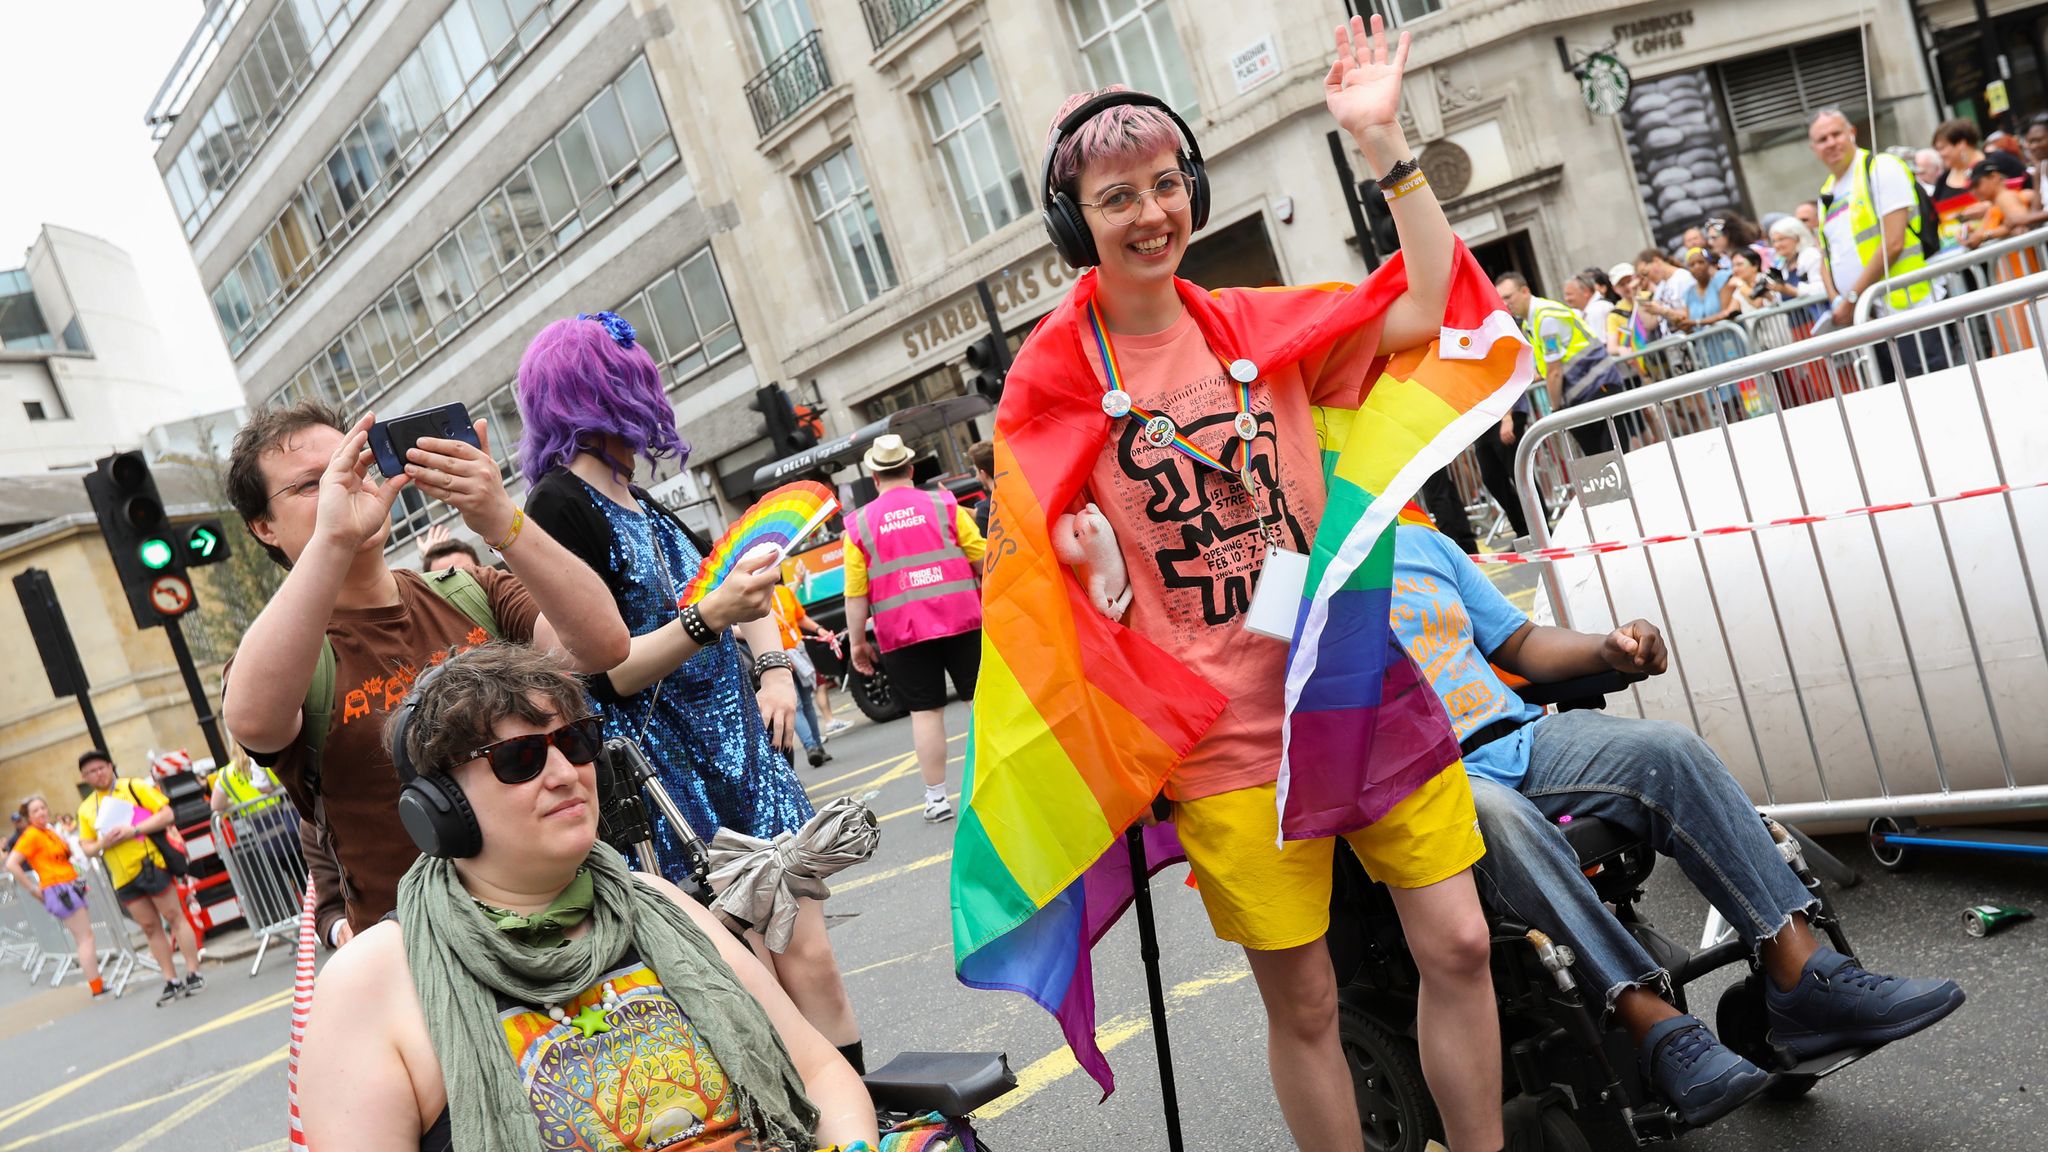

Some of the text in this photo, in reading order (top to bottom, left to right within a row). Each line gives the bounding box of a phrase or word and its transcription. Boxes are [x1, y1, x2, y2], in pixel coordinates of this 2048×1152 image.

[1613, 10, 1694, 41] STARBUCKS
[1633, 30, 1684, 57] COFFEE
[902, 267, 1040, 359] STARBUCKS
[783, 455, 811, 473] DELTA
[879, 514, 927, 535] MANAGER
[883, 506, 915, 523] EVENT
[908, 565, 942, 580] PRIDE IN
[909, 573, 944, 588] LONDON
[1214, 567, 1234, 582] SHOW
[1235, 562, 1254, 573] RUNS
[1450, 681, 1490, 714] FIVE
